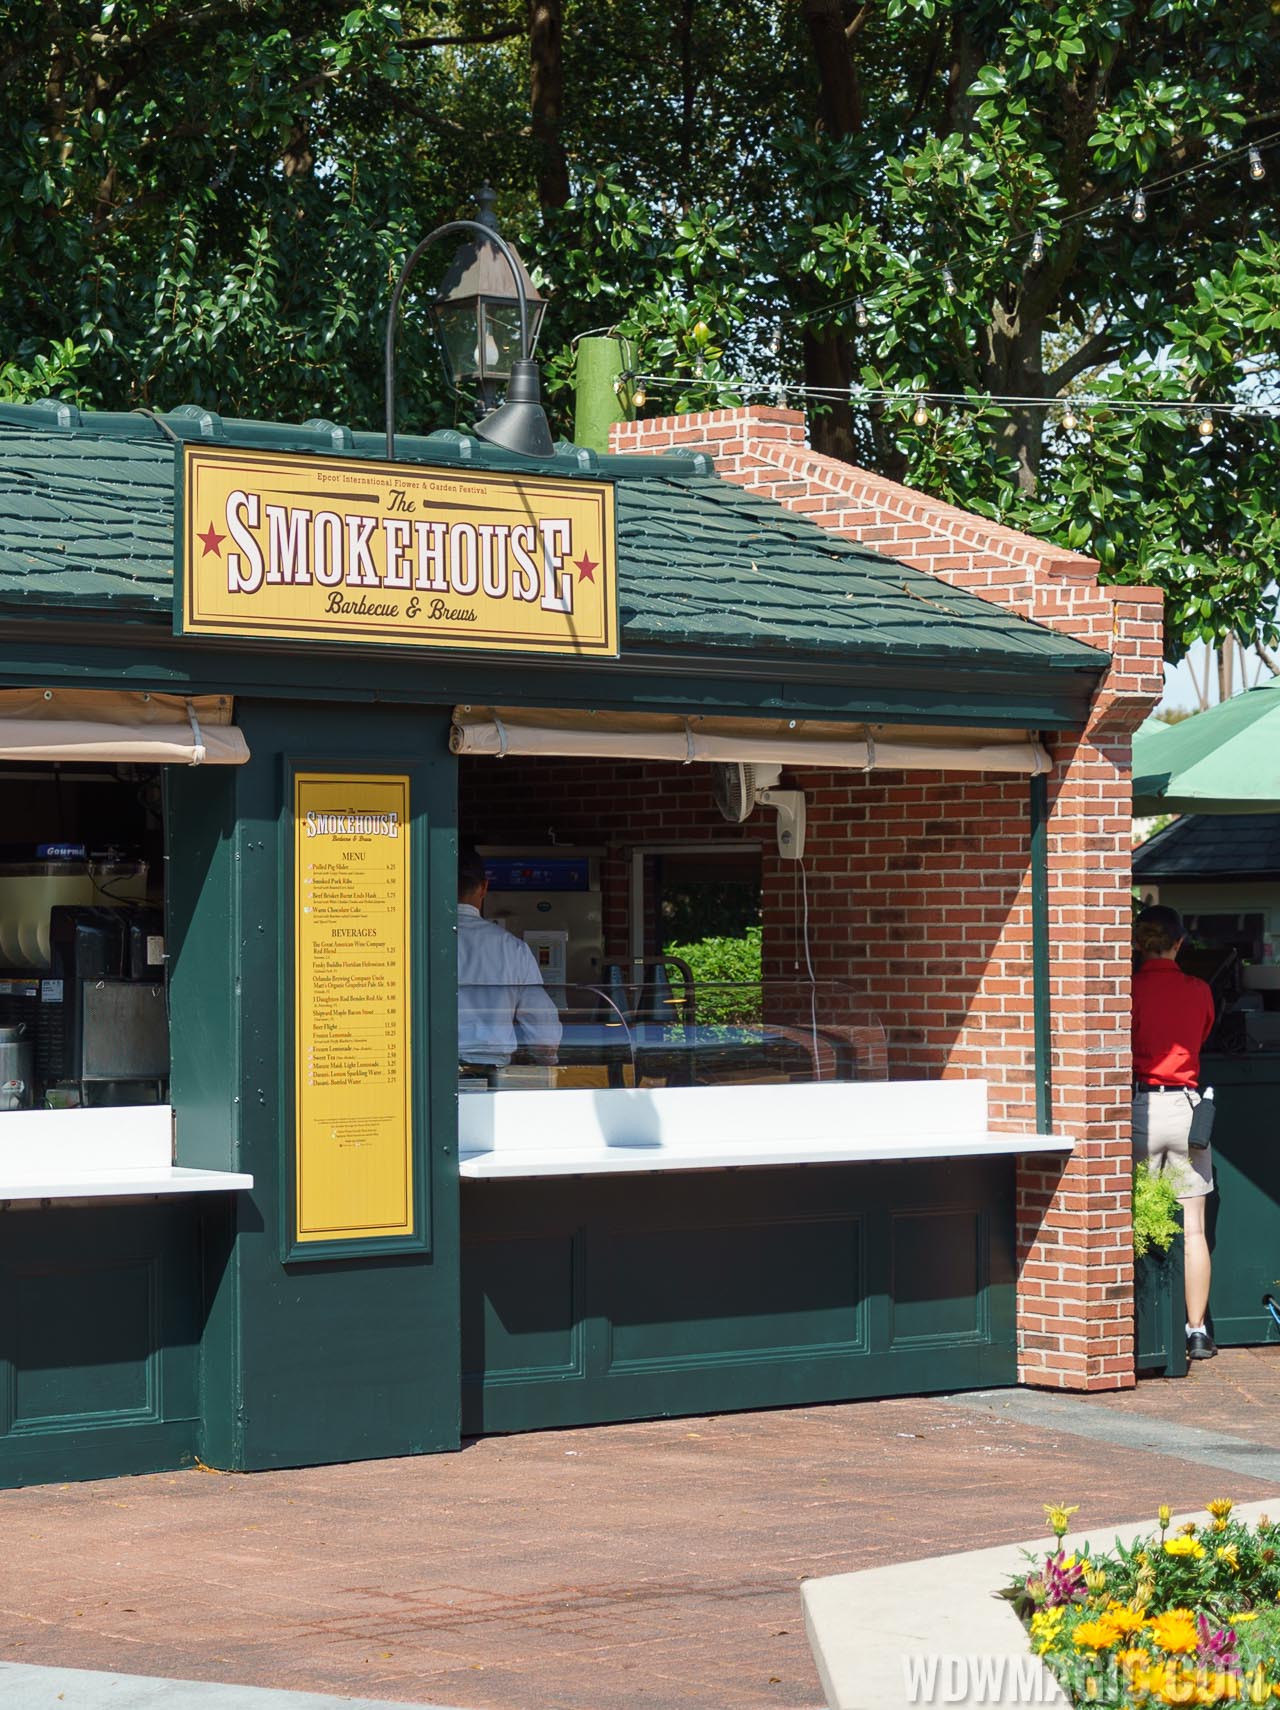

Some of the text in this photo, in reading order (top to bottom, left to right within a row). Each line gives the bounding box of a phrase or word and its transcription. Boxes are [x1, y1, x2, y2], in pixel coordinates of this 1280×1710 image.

[343, 475, 392, 487] International
[394, 479, 420, 489] Flower
[430, 483, 457, 492] Garden
[460, 485, 487, 495] Festival
[387, 489, 416, 512] The
[226, 490, 573, 614] SMOKEHOUSE
[325, 591, 477, 621] Barbecue & Brews
[306, 810, 398, 839] SMOKEHOUSE
[342, 852, 366, 860] MENU
[331, 929, 377, 937] BEVERAGES
